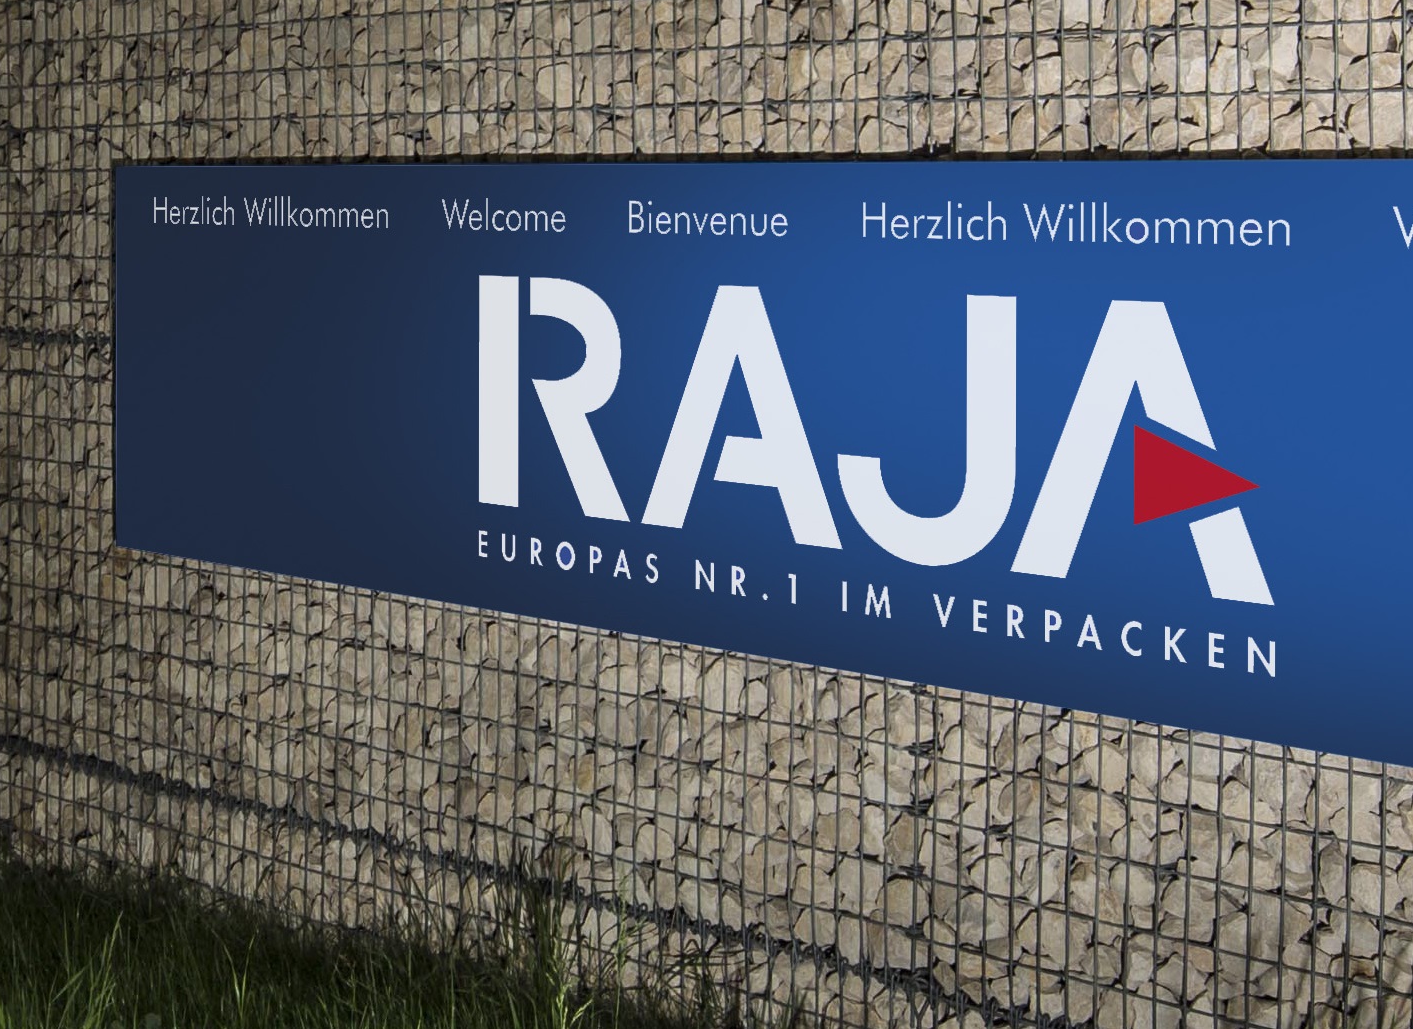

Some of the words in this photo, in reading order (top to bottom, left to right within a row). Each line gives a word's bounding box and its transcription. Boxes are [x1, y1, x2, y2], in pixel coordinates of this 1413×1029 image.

[153, 195, 236, 226] Herzlich
[243, 195, 390, 230] Willkommen
[441, 197, 567, 233] Welcome
[628, 200, 789, 237] Bienvenue
[862, 201, 1008, 241] Herzlich
[1022, 202, 1291, 247] Willkommen
[478, 274, 1276, 606] RAJA
[478, 529, 659, 584] EUROPAS
[841, 580, 892, 620] IM
[932, 592, 1276, 678] VERPACKEN
